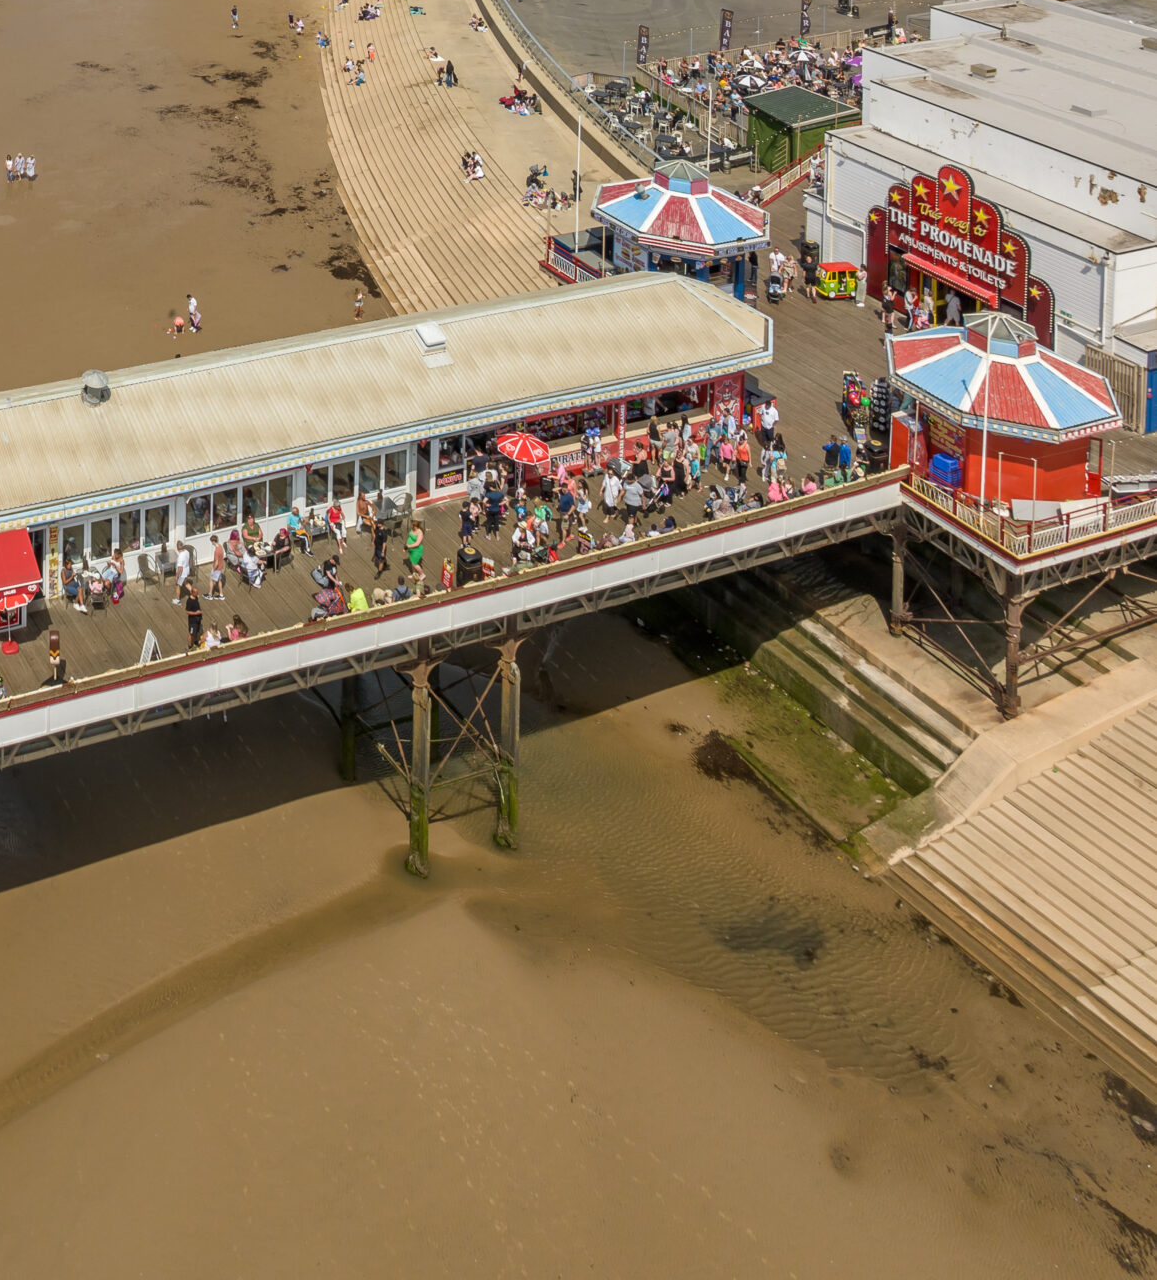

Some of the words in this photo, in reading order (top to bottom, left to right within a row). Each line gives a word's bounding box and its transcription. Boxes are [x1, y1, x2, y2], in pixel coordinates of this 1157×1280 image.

[722, 20, 731, 46] BAR
[917, 202, 942, 221] This
[944, 216, 970, 234] way
[973, 224, 987, 237] to
[889, 206, 918, 232] THE
[920, 220, 1019, 278] PROMENADE
[899, 233, 959, 266] AMUSEMENTS
[965, 264, 1007, 290] TOILETS
[437, 474, 462, 486] DONUTS
